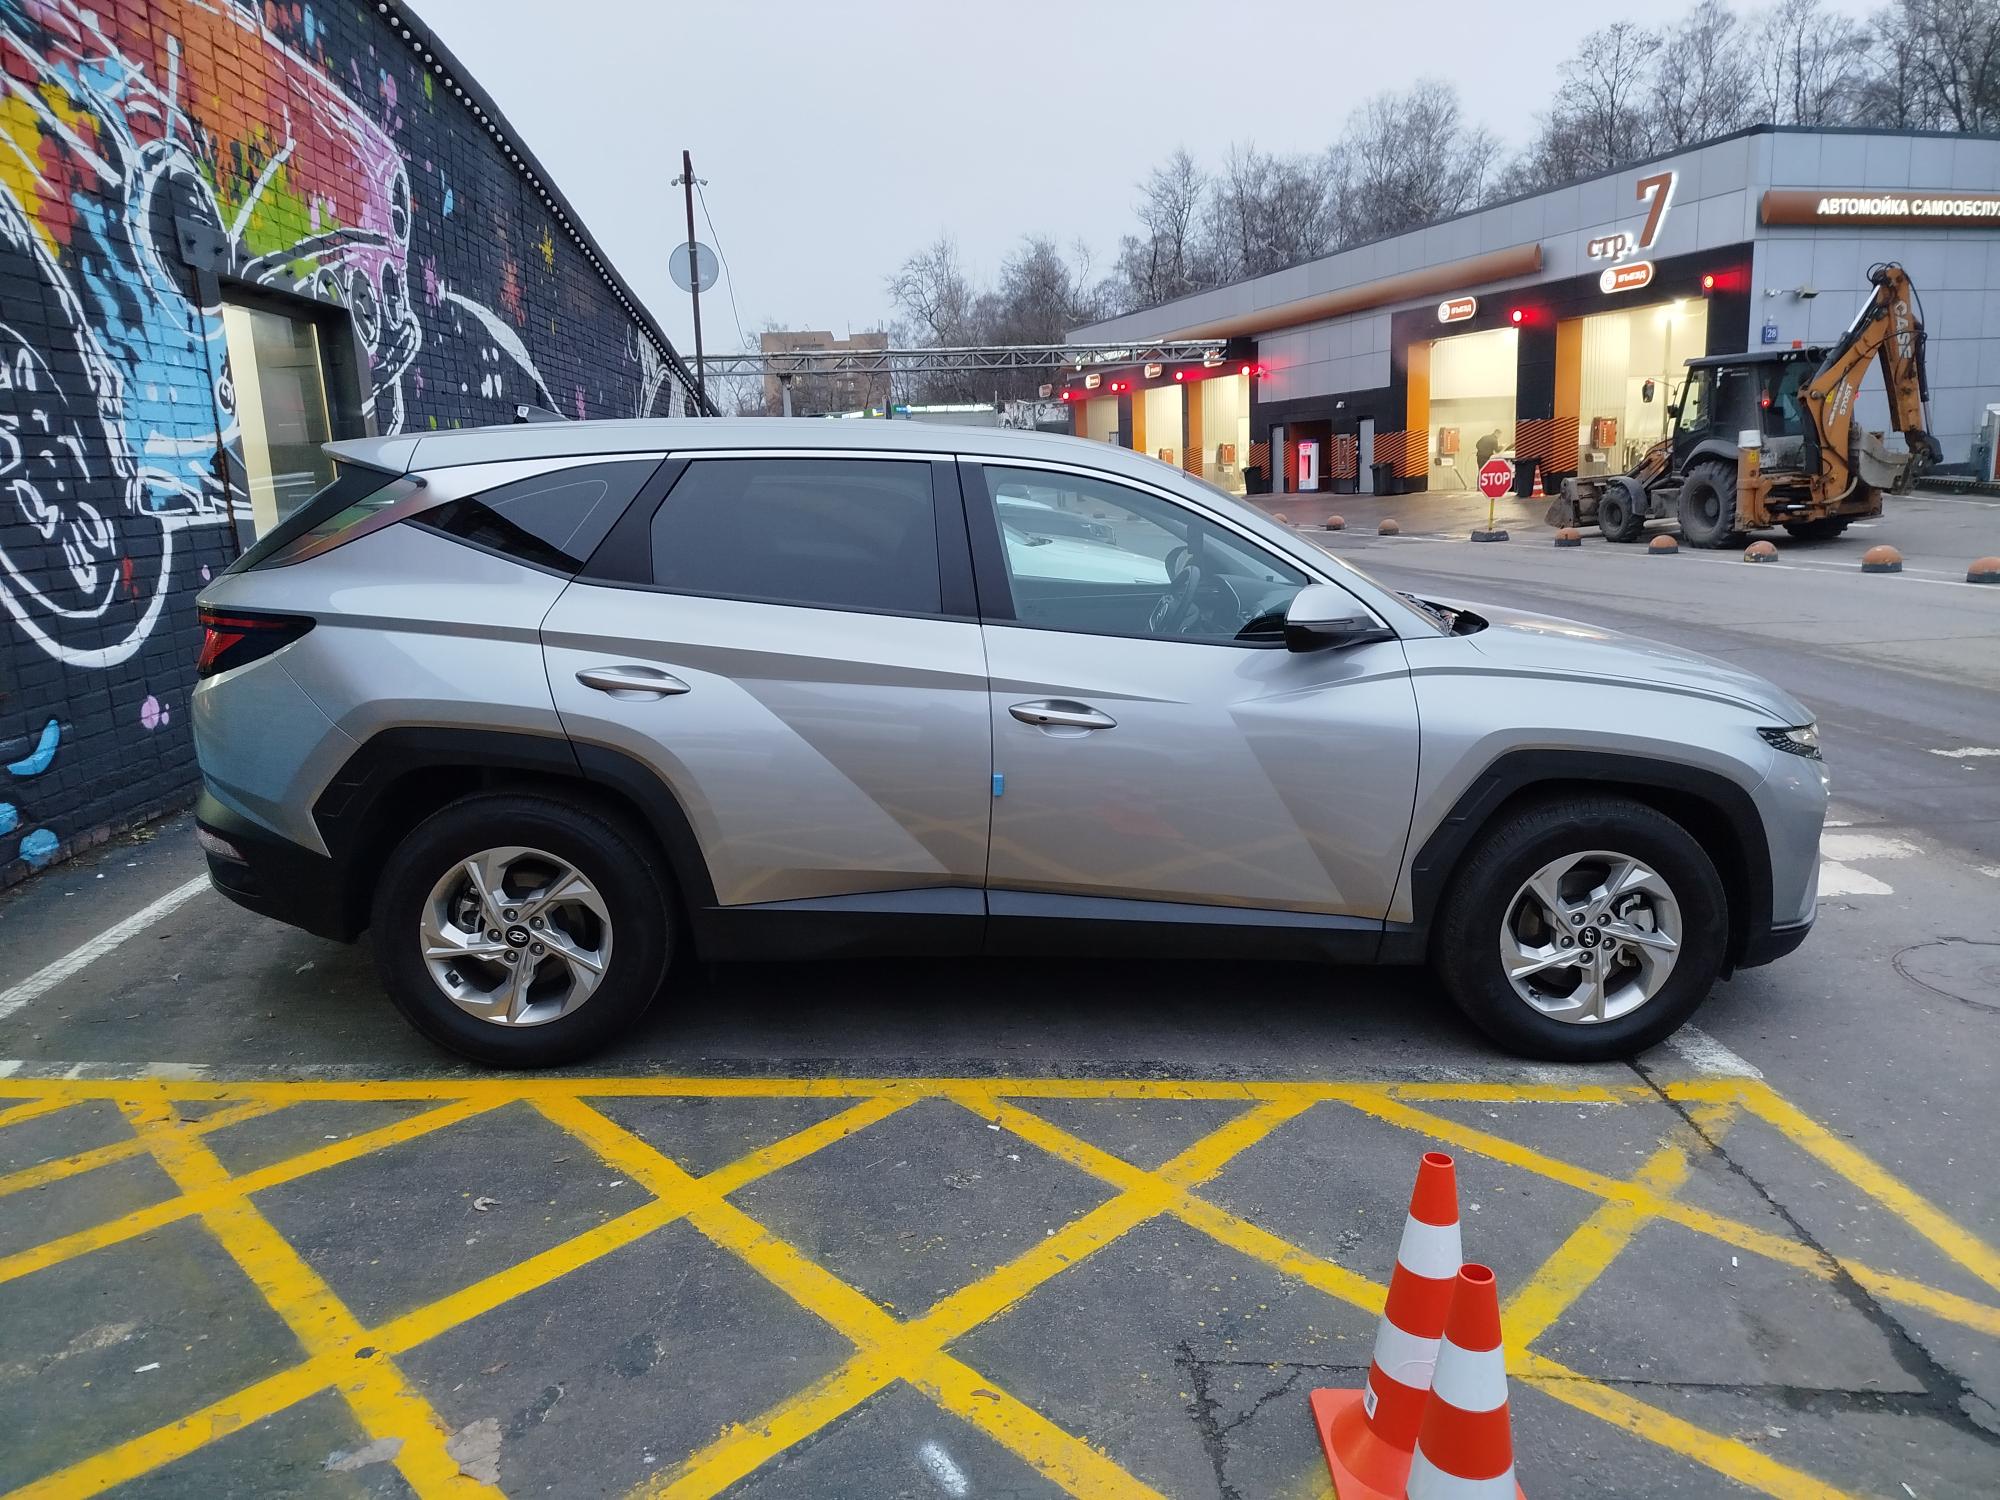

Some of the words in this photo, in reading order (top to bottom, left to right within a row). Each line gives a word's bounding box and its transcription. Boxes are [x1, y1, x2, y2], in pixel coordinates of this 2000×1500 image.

[1817, 196, 1909, 215] АВТОМОЙКА
[1587, 234, 1633, 261] стр.
[1637, 172, 1675, 249] 7
[1767, 328, 1777, 338] 28
[1481, 472, 1511, 486] STOP
